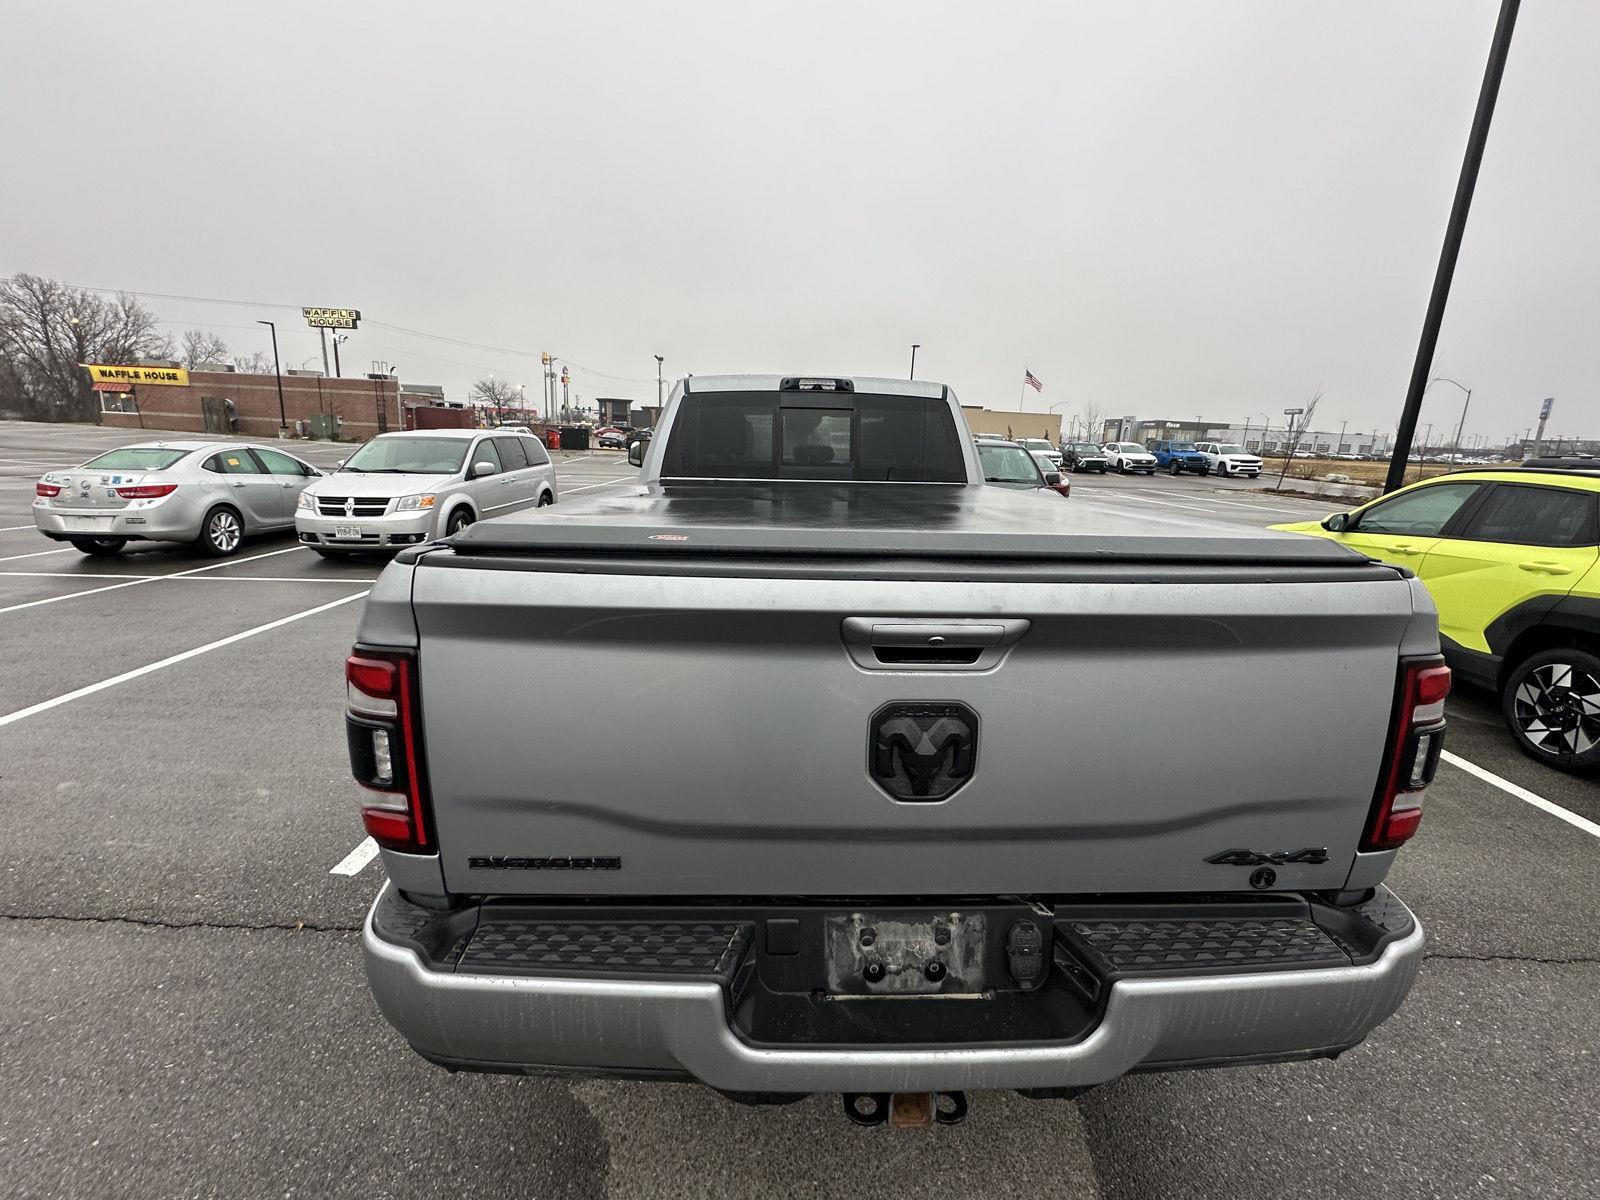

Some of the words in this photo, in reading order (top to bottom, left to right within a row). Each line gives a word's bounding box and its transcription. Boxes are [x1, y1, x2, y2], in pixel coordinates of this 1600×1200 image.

[303, 309, 355, 318] WAFFLE
[309, 318, 352, 327] HOUSE
[99, 369, 141, 379] WAFFLE
[143, 371, 179, 381] HOUSE
